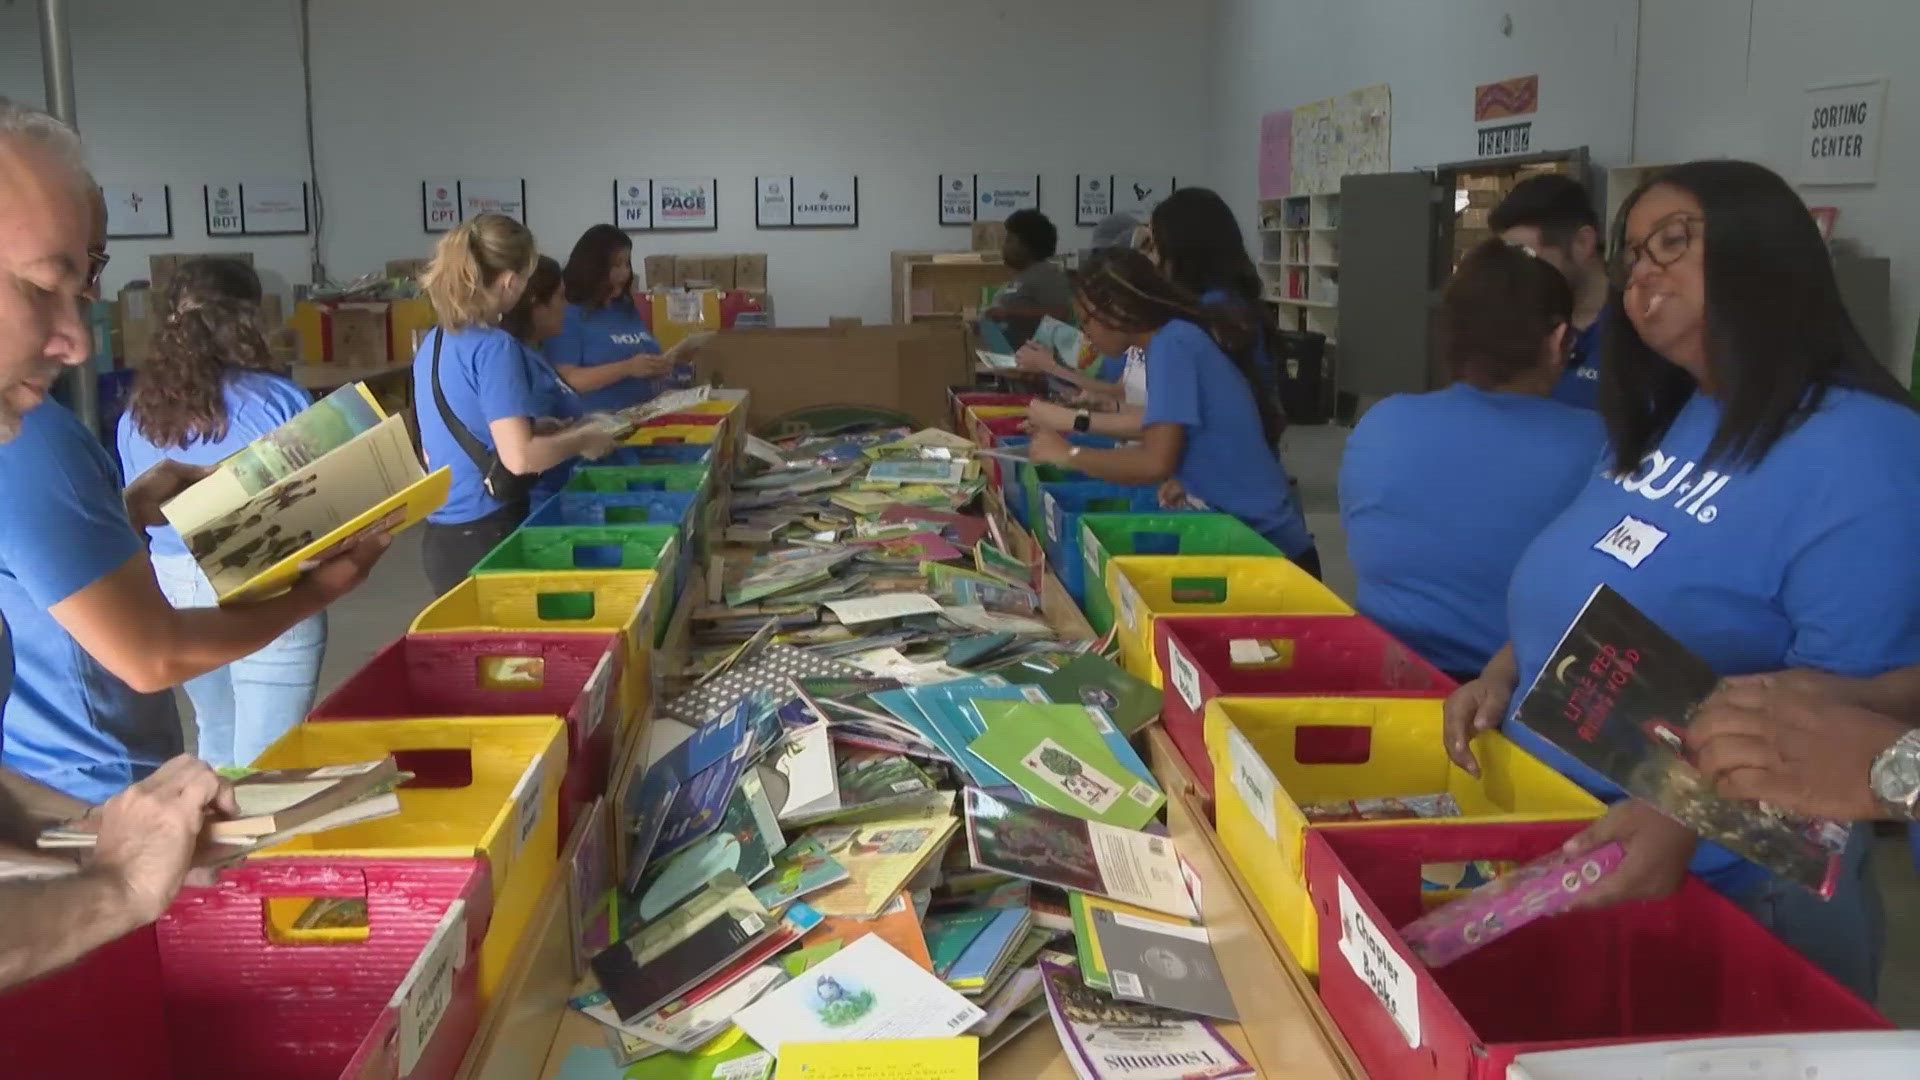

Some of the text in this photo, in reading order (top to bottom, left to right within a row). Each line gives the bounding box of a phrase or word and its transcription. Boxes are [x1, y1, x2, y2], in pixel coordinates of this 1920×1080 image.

[1812, 101, 1867, 130] SORTING
[1811, 134, 1863, 158] CENTER
[431, 210, 455, 222] CPT
[661, 197, 706, 209] PAGE
[798, 204, 851, 213] EMERSON
[1605, 524, 1641, 555] Nea
[1589, 643, 1617, 675] RED
[1355, 911, 1400, 985] Chapter
[1363, 951, 1398, 1016] Books
[1104, 1051, 1221, 1074] Tsunamis
